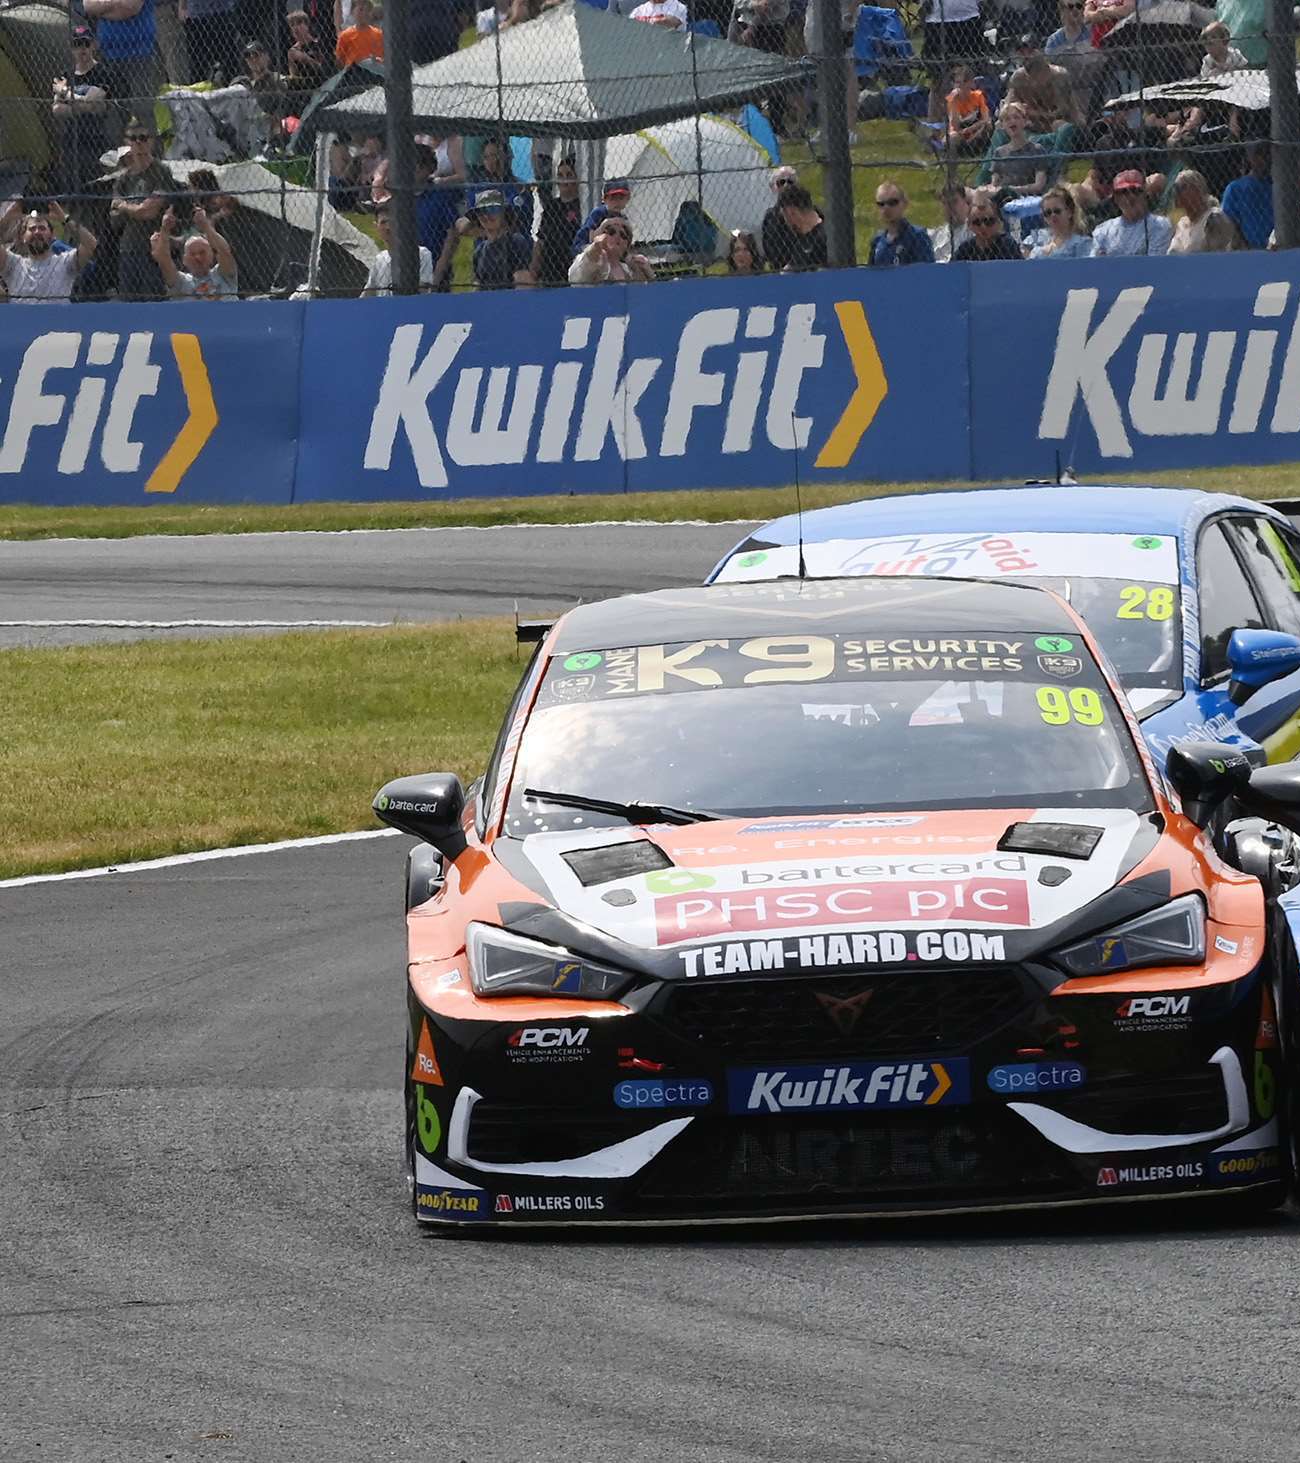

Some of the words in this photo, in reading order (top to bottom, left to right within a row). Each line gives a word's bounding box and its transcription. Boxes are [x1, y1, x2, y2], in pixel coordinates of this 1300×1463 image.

[0, 331, 161, 474] Fit
[1116, 586, 1174, 621] 28
[843, 638, 1023, 655] SECURITY
[638, 636, 834, 691] K9
[847, 656, 1023, 673] SERVICES
[1036, 686, 1104, 726] 99
[389, 798, 438, 813] bartercard
[741, 855, 1027, 886] bartercard
[675, 888, 873, 930] PHSC
[908, 883, 1009, 917] plc
[678, 930, 1006, 977] TEAM-HARD.COM
[994, 1066, 1082, 1089] Spectra
[620, 1085, 709, 1105] Spectra
[1119, 1165, 1174, 1181] MILLERS
[1177, 1163, 1203, 1177] OILS
[515, 1197, 571, 1210] MILLERS
[575, 1197, 604, 1210] OILS
